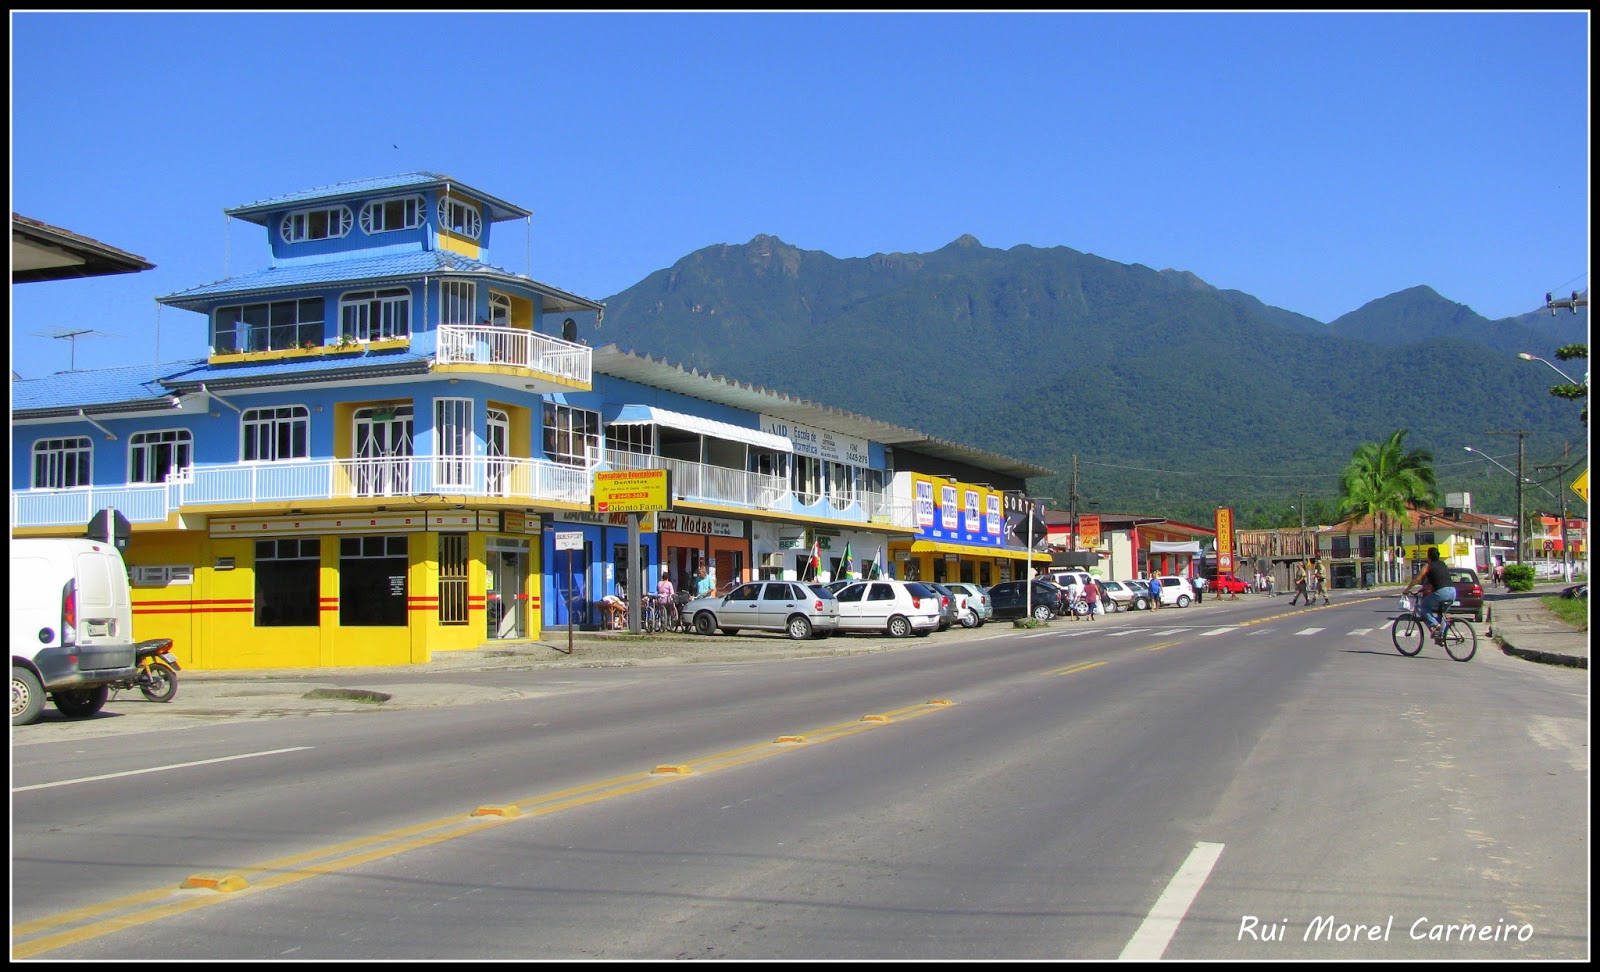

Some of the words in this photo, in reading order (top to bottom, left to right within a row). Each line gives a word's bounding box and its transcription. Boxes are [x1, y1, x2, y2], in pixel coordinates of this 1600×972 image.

[794, 426, 810, 440] Escola
[811, 431, 817, 442] de
[658, 516, 678, 530] ranci
[681, 515, 713, 533] Modas
[1220, 512, 1228, 550] KOERICH
[780, 540, 800, 549] BESC
